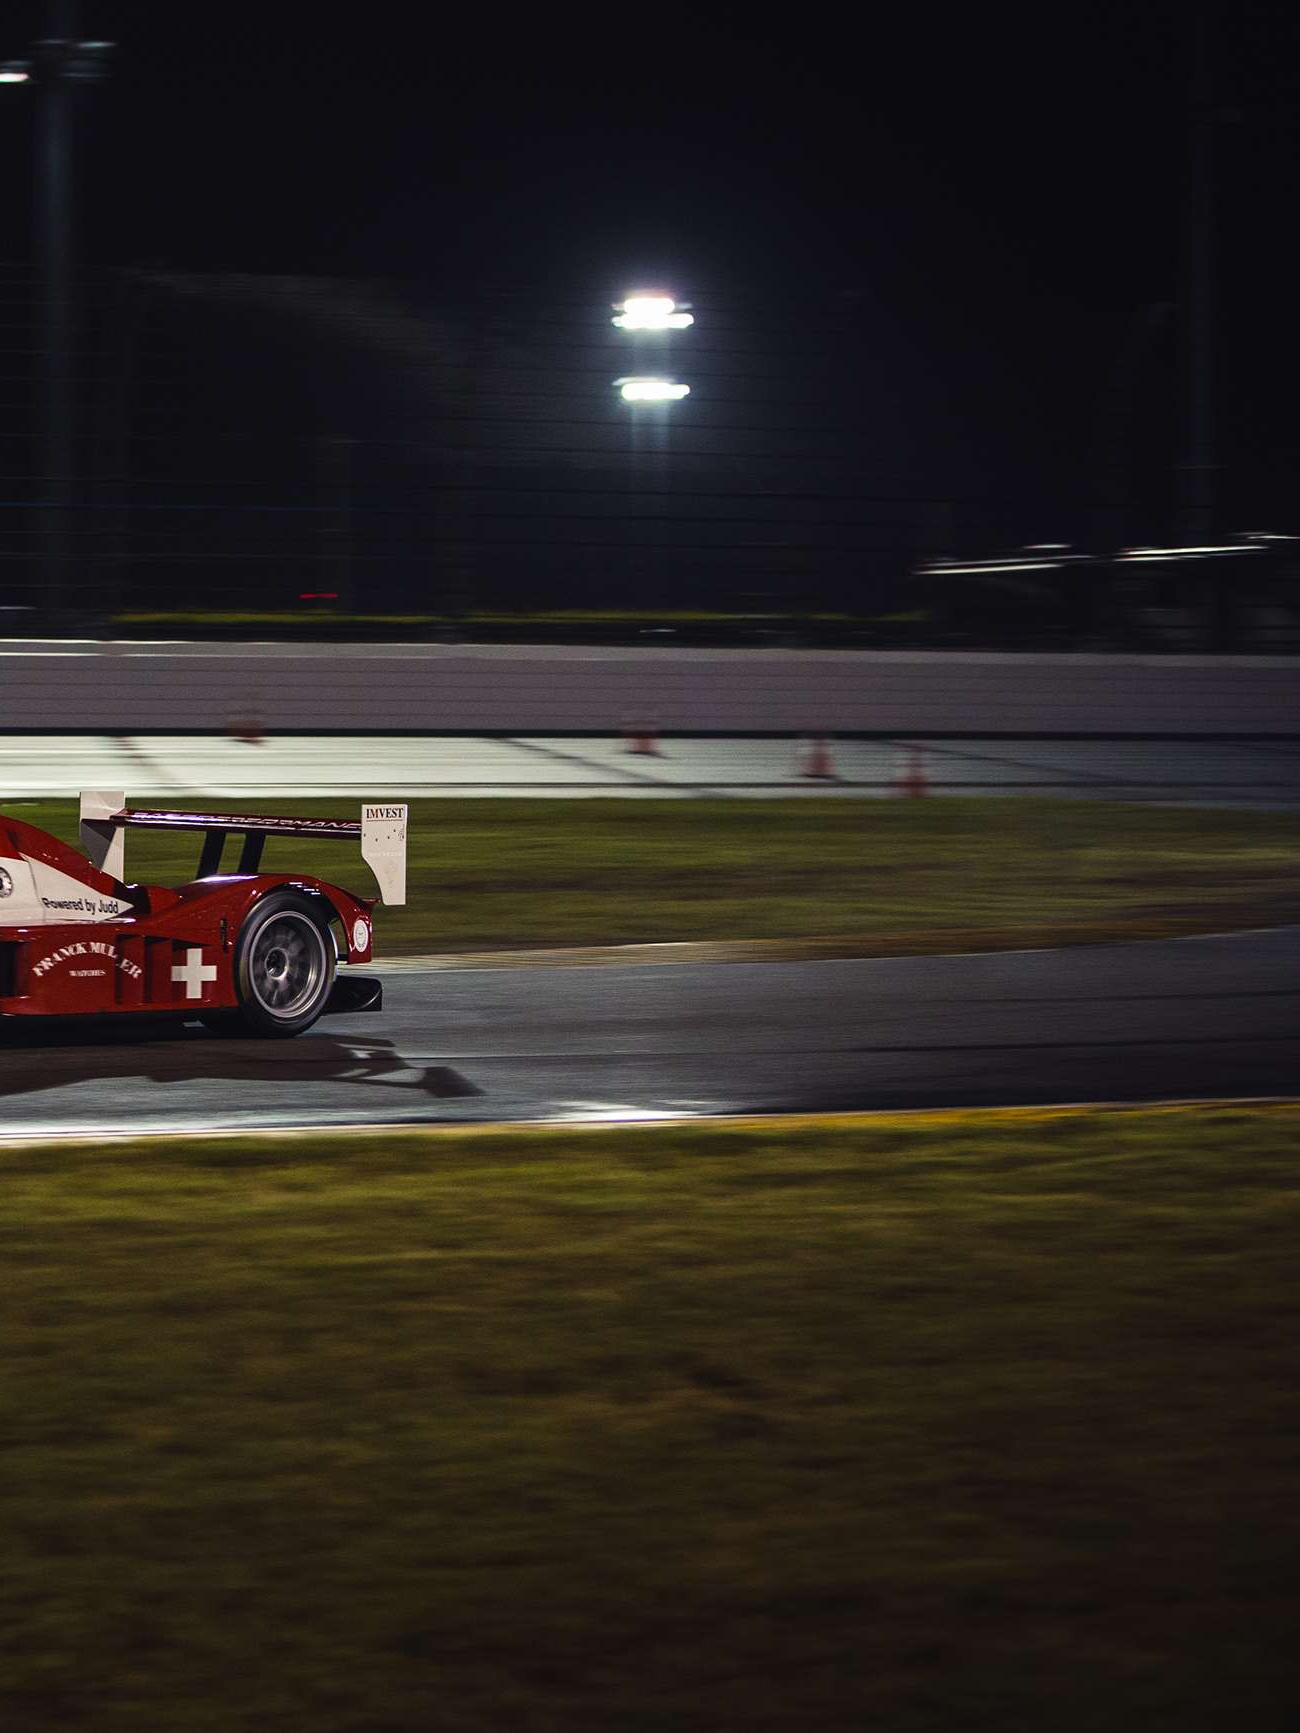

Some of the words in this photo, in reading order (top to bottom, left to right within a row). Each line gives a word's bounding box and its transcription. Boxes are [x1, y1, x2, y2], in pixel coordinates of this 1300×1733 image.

[366, 808, 404, 820] IMVEST
[42, 897, 82, 910] Powered
[84, 898, 97, 915] by
[98, 899, 119, 914] Judd
